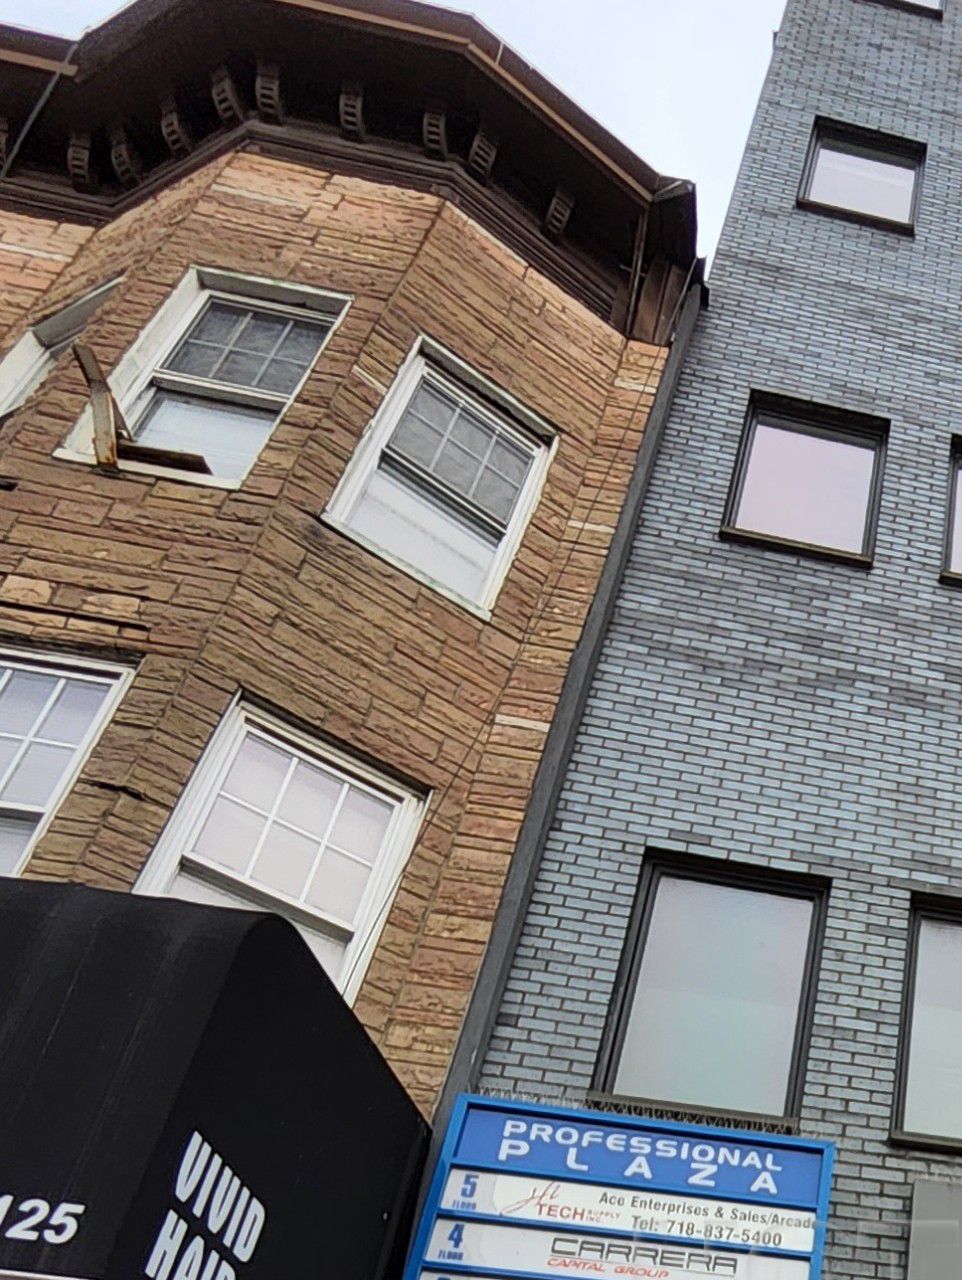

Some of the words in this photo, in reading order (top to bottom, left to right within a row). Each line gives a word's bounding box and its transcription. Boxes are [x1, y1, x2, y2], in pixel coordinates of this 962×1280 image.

[503, 1119, 783, 1172] PROFESSIONAL
[498, 1139, 779, 1195] PLAZA
[175, 1130, 266, 1264] VIVID
[461, 1173, 480, 1199] 5
[536, 1201, 586, 1221] TECH
[599, 1190, 626, 1208] Ace
[630, 1195, 710, 1218] Enterprises
[714, 1204, 725, 1219] &
[447, 1223, 466, 1249] 4
[631, 1214, 660, 1232] Tel:
[666, 1220, 783, 1247] 718-837-5400
[547, 1258, 606, 1273] CAPITAL
[614, 1264, 672, 1280] GROUP
[550, 1236, 738, 1276] CARRERA
